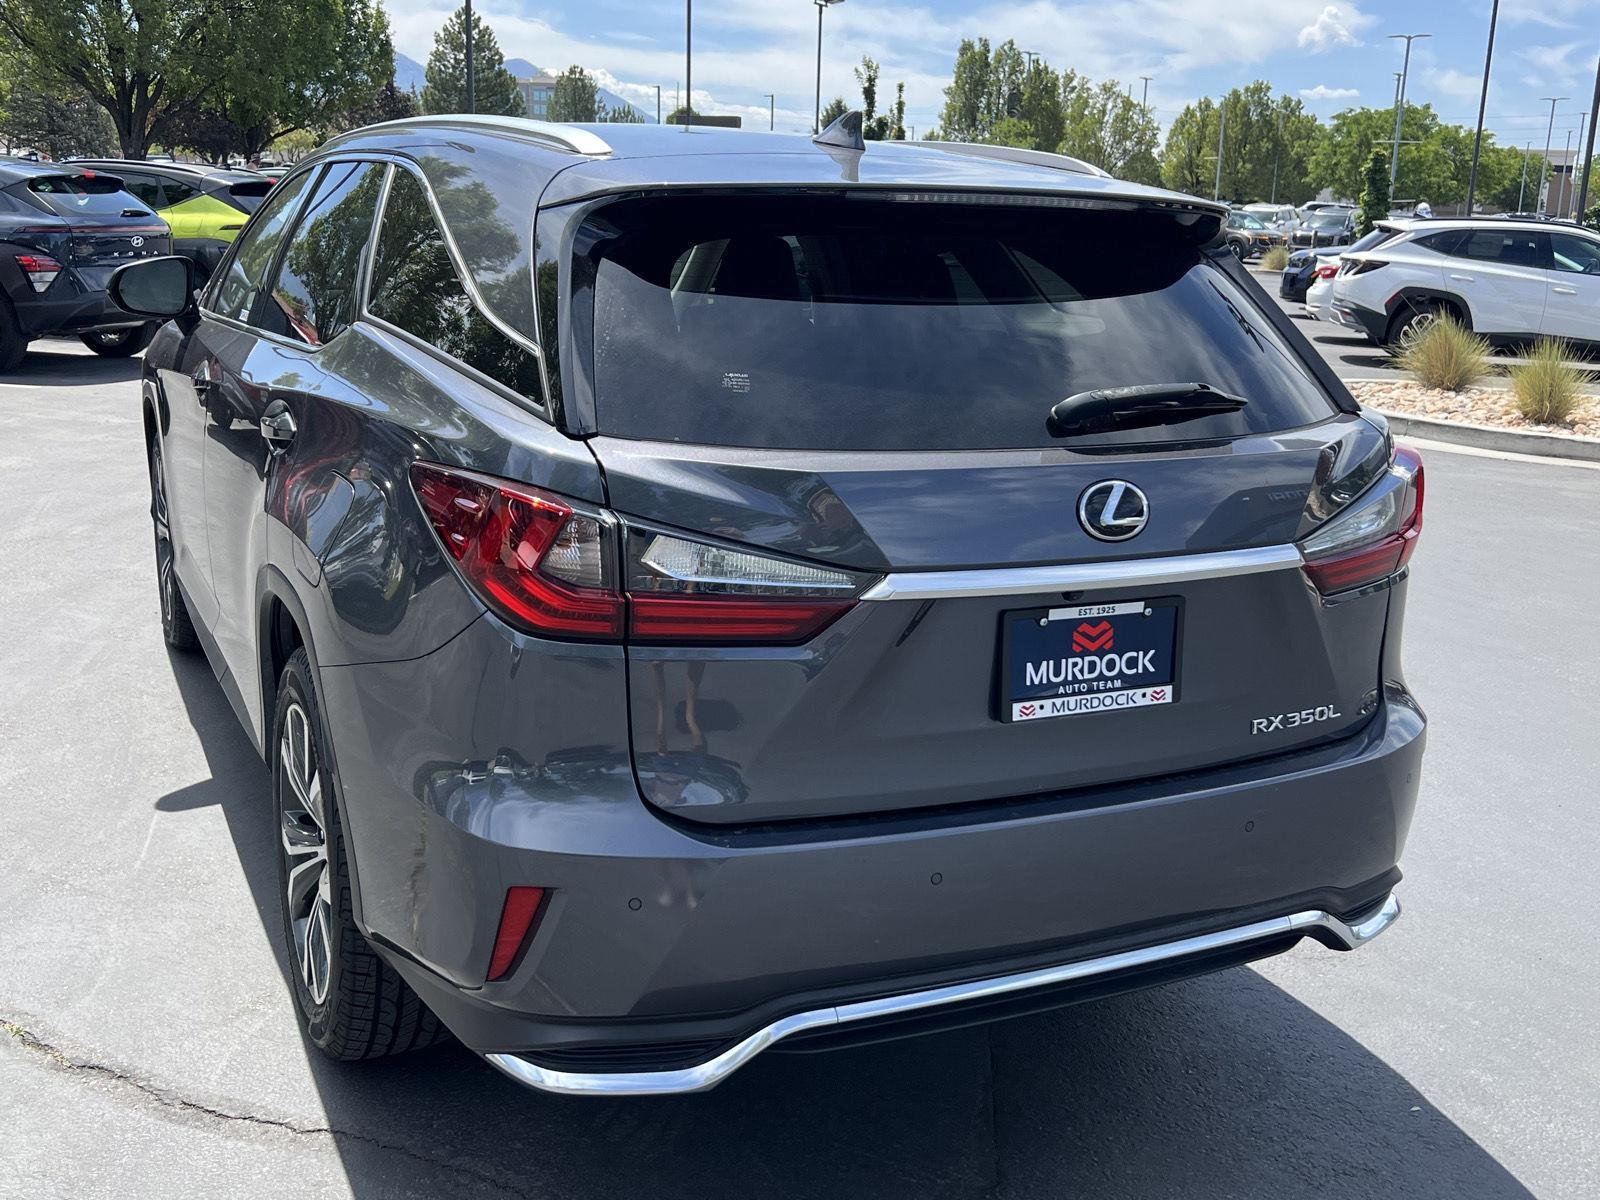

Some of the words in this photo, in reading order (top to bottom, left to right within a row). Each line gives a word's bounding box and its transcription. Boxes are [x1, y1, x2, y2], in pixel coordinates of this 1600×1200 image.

[1078, 607, 1095, 616] EST.
[1096, 605, 1116, 615] 1925
[1025, 649, 1156, 686] MURDOCK
[1058, 682, 1088, 695] AUTO
[1092, 679, 1122, 690] TEAM
[1051, 691, 1138, 714] MURDOCK
